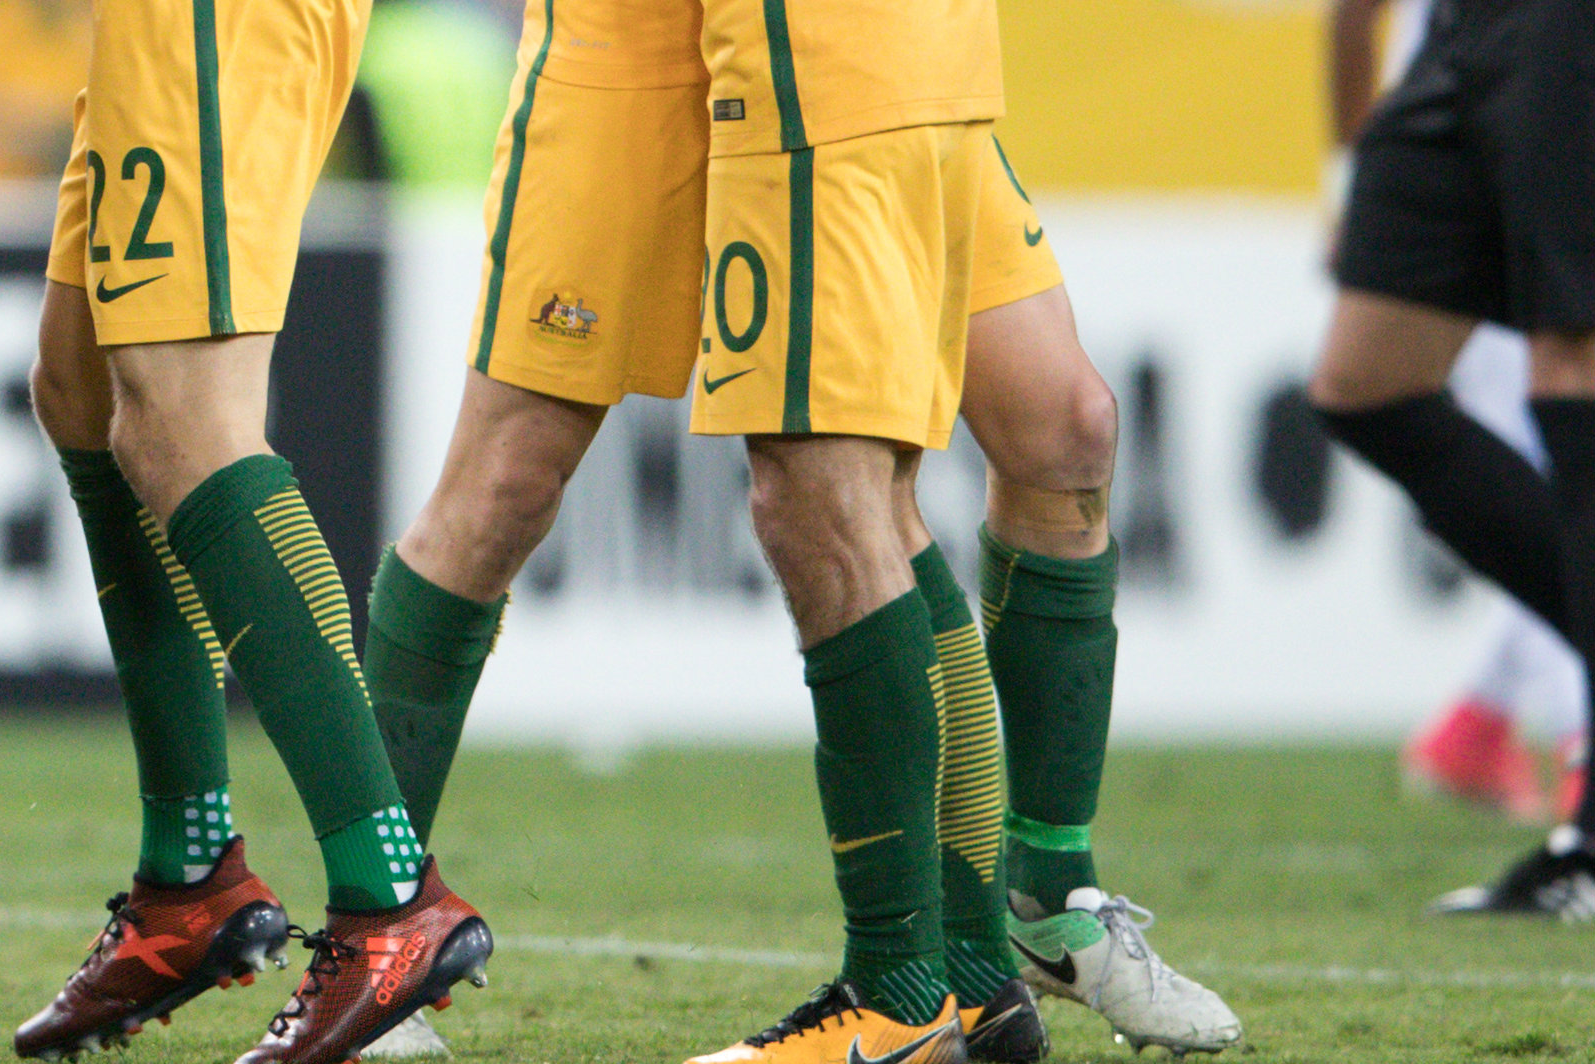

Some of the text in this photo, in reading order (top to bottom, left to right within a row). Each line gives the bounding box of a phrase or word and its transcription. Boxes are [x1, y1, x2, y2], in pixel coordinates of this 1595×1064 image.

[86, 146, 175, 264] 22
[701, 240, 770, 354] 0
[375, 930, 427, 1006] adidas
